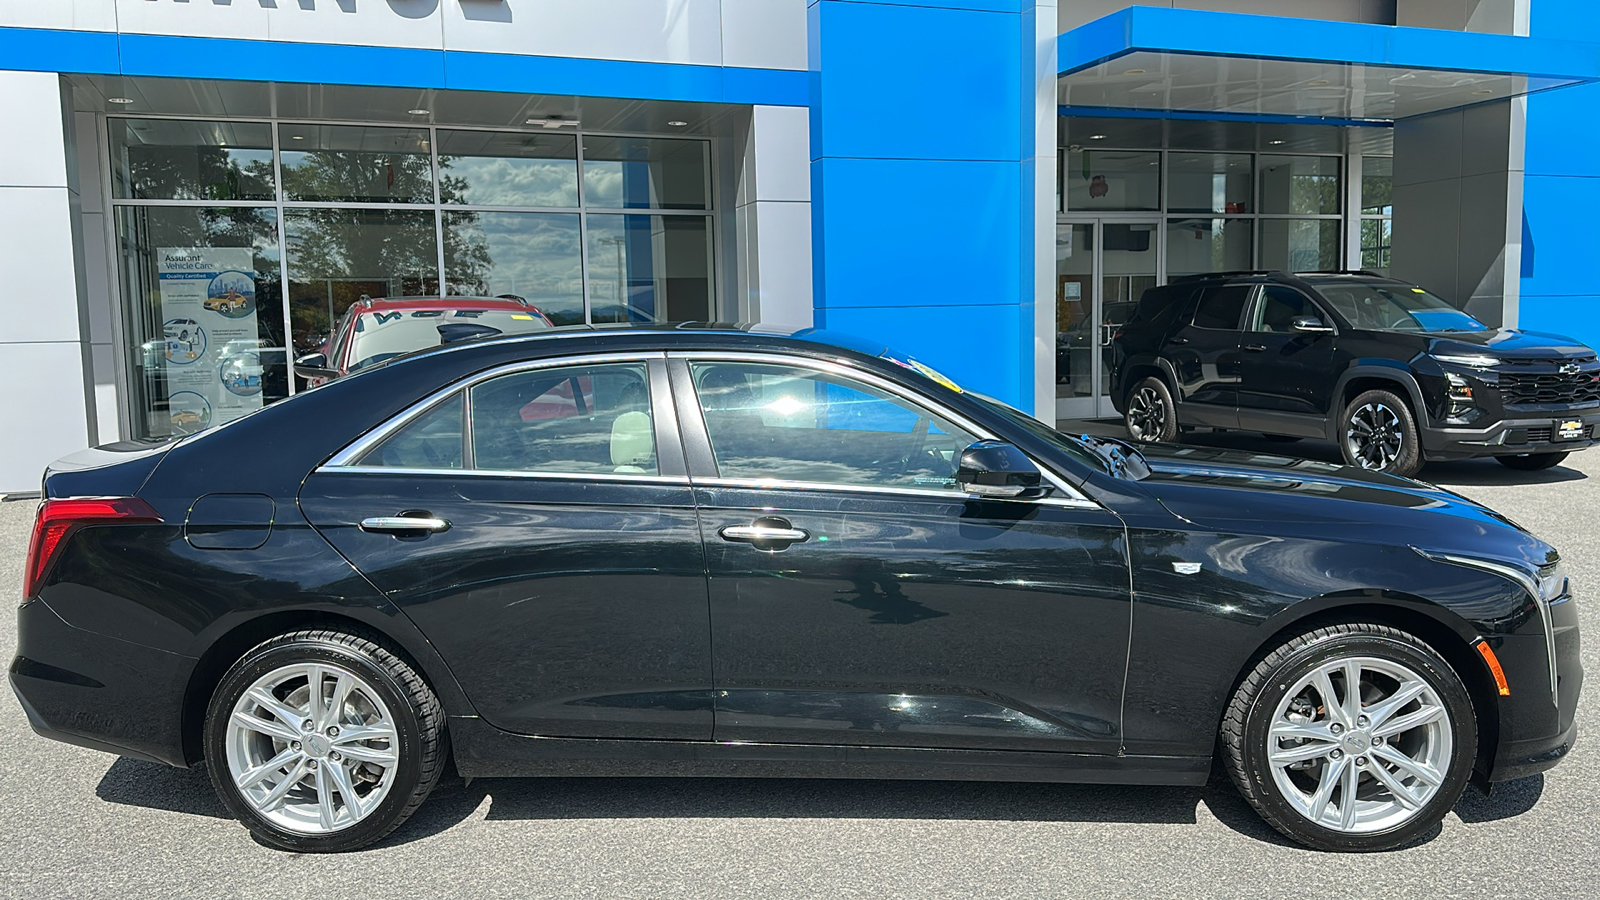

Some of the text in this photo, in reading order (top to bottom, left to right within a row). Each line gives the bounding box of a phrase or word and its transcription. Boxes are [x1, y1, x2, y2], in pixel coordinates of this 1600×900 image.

[165, 254, 201, 262] Assurant
[165, 262, 213, 270] Vehicle Care
